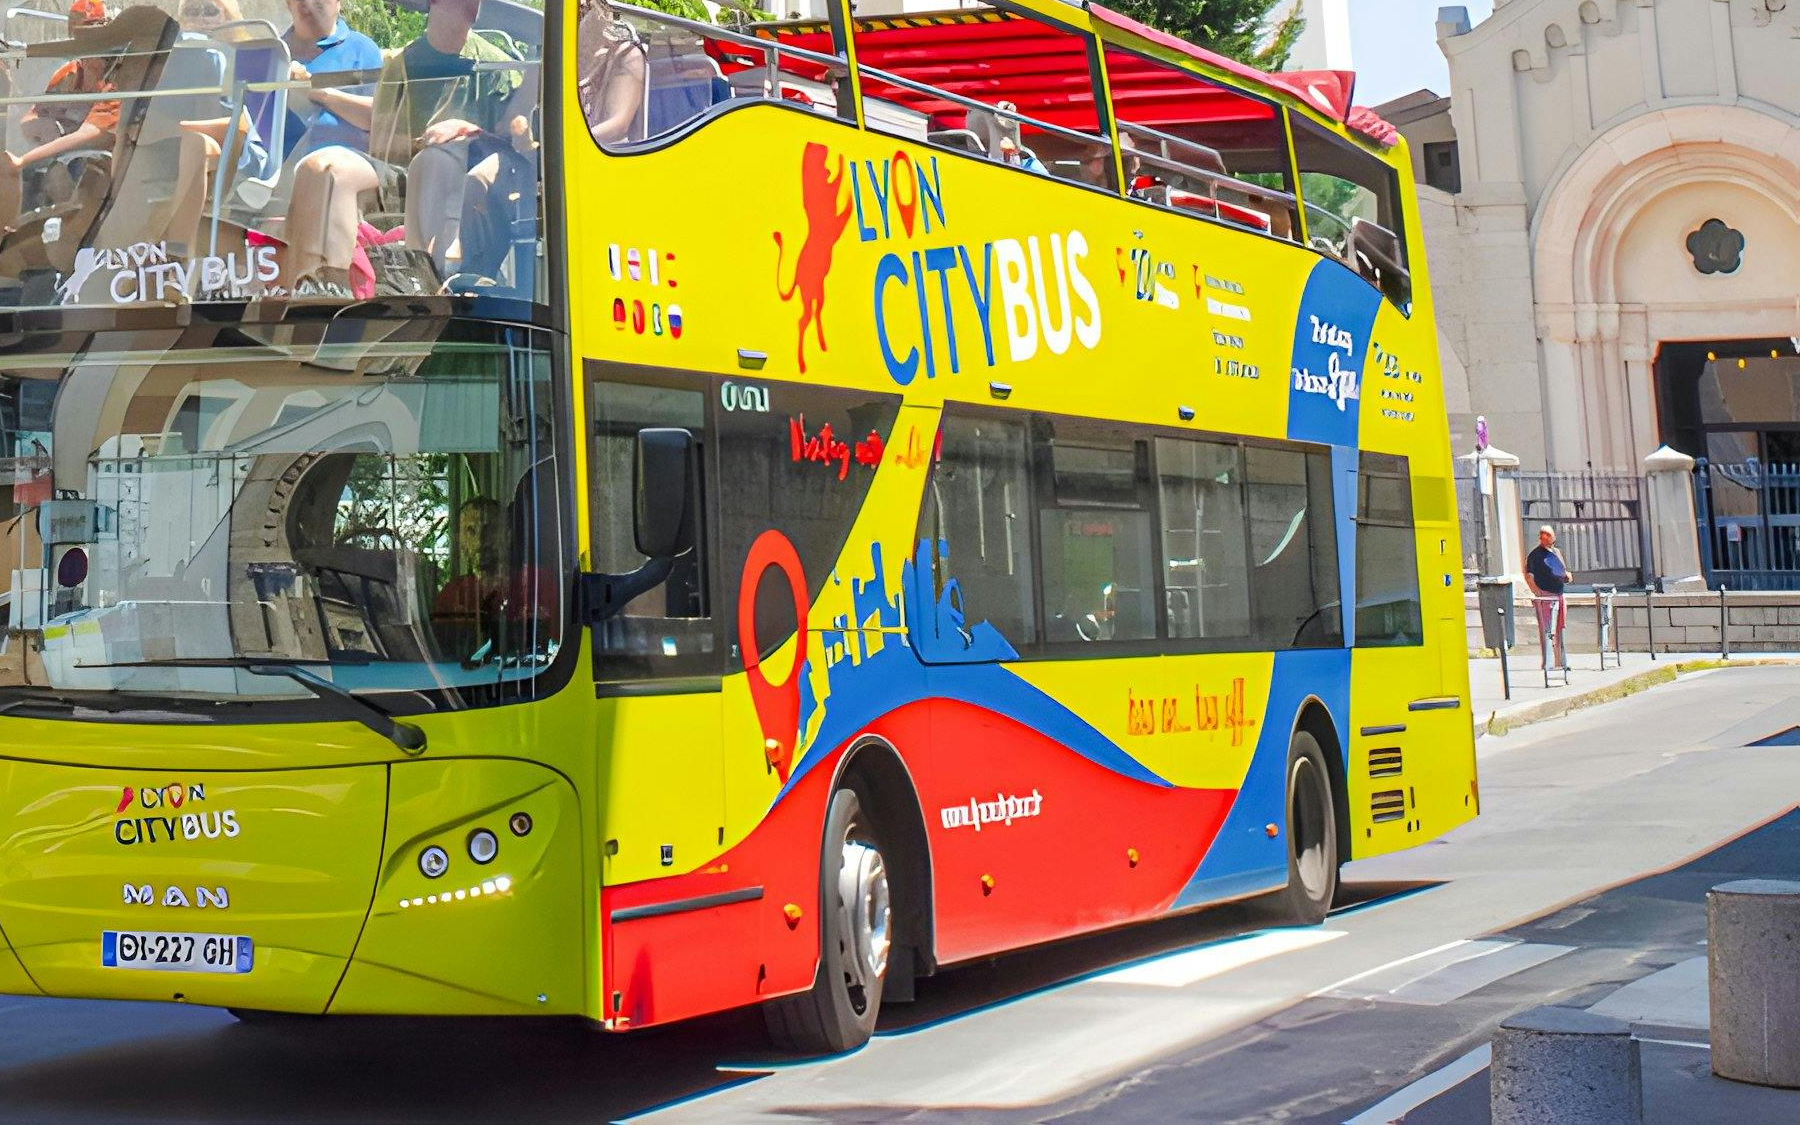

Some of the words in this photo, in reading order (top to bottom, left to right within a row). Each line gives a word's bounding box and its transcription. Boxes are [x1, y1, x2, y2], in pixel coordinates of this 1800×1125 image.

[849, 150, 946, 242] LYON
[873, 229, 1102, 386] CITYBUS
[140, 782, 205, 809] LYON
[114, 810, 241, 845] CITYBUS
[123, 883, 229, 909] MAN
